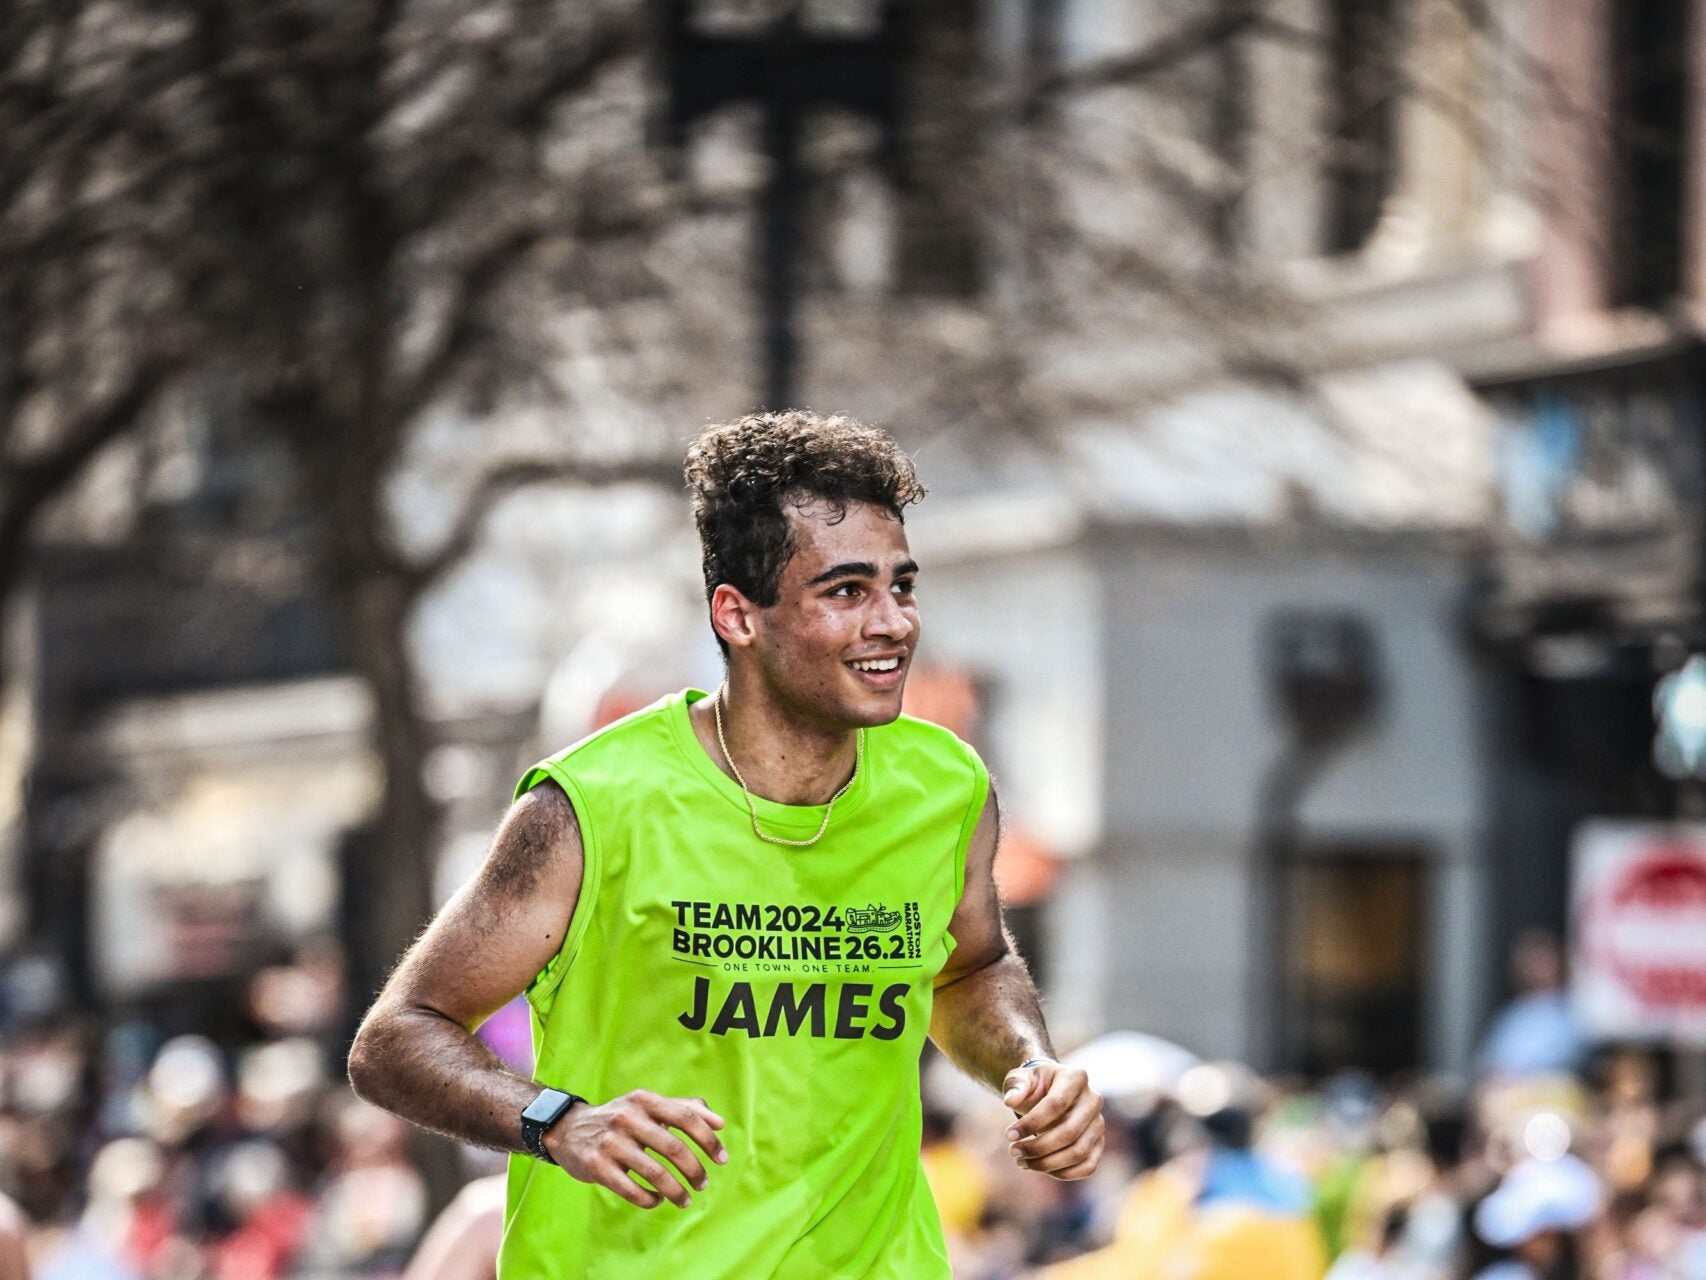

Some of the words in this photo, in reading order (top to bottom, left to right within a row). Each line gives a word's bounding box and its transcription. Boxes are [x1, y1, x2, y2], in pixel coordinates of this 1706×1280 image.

[671, 900, 761, 931] TEAM
[765, 905, 845, 932] 2024
[904, 902, 915, 959] MARATHON
[911, 902, 922, 959] BOSTON
[672, 928, 844, 960] BROOKLINE
[845, 935, 906, 960] 26.2
[723, 962, 746, 972] ONE
[802, 963, 829, 973] ONE
[835, 964, 875, 974] TEAM.
[677, 976, 911, 1041] JAMES
